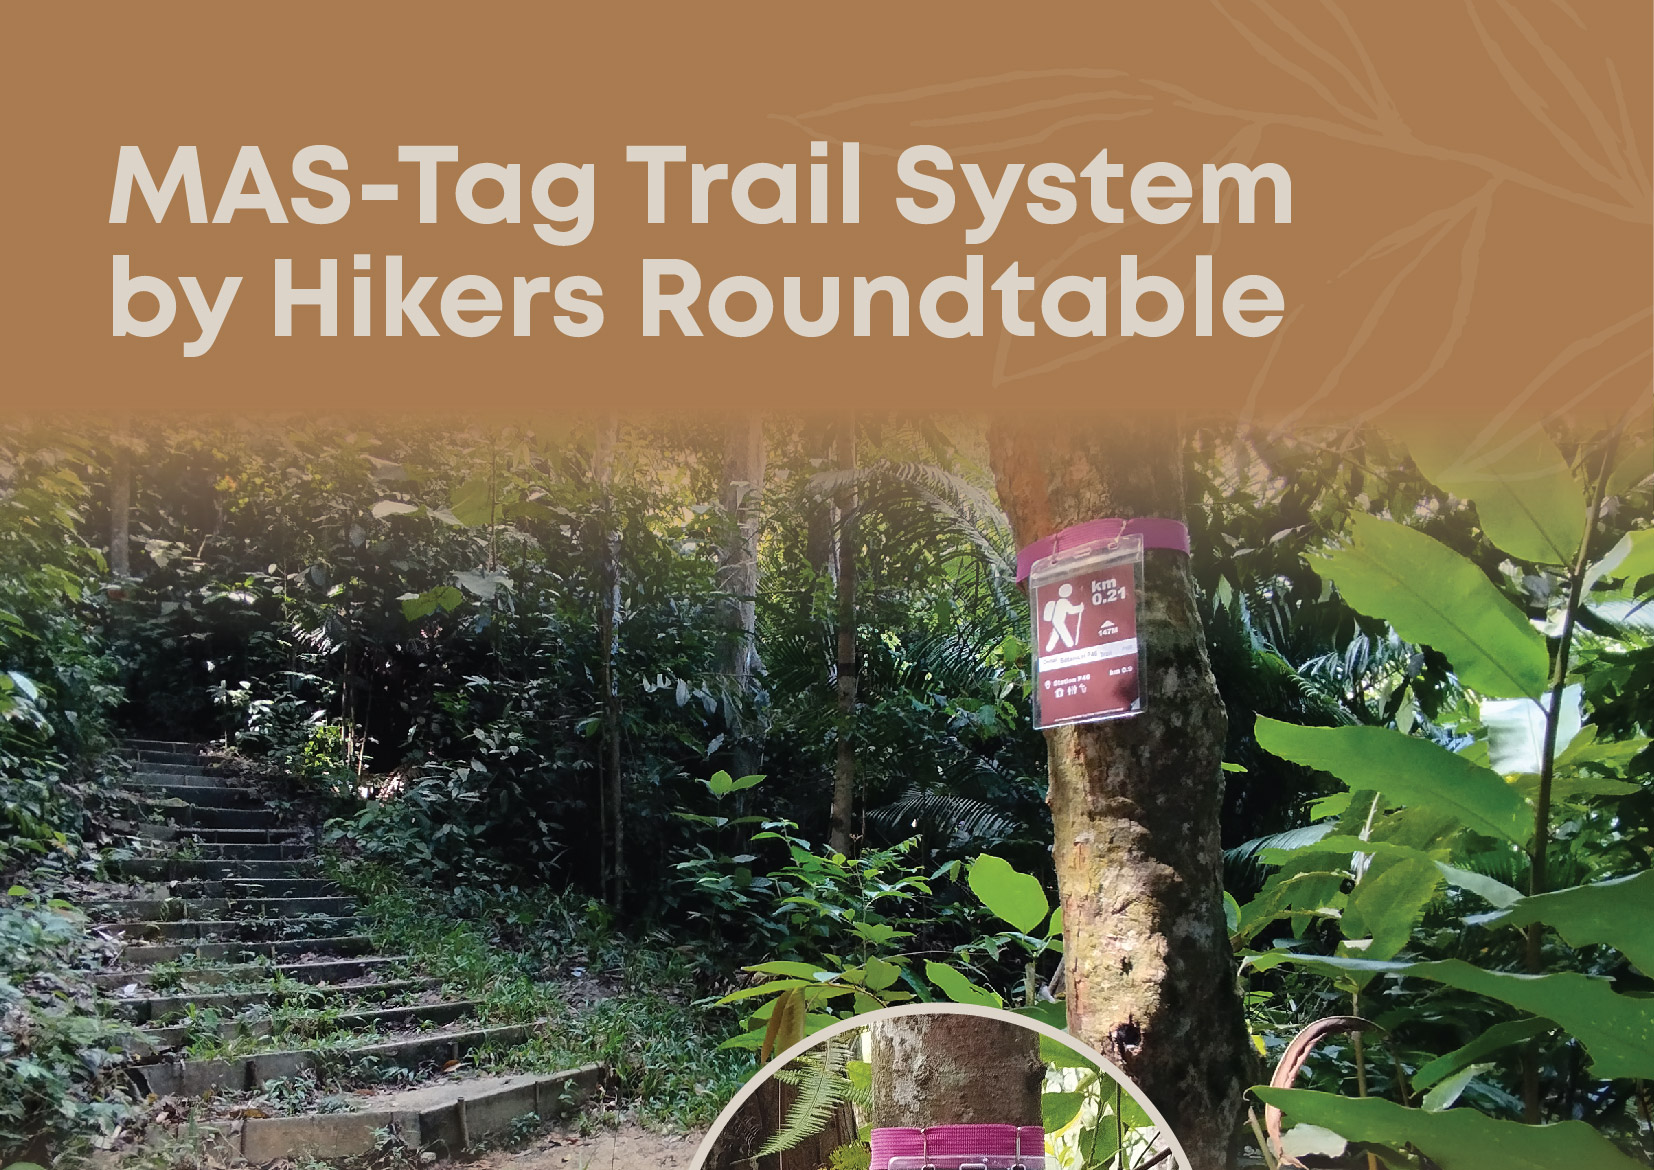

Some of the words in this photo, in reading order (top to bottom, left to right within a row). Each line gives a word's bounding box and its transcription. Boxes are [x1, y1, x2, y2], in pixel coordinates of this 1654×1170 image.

[109, 145, 594, 246] MAS-Tag
[627, 141, 859, 224] Trail
[896, 145, 1291, 244] System
[113, 255, 243, 357] by
[275, 254, 604, 337] Hikers
[643, 255, 1284, 338] Roundtable
[1091, 578, 1116, 593] km
[1092, 586, 1126, 606] 0.21
